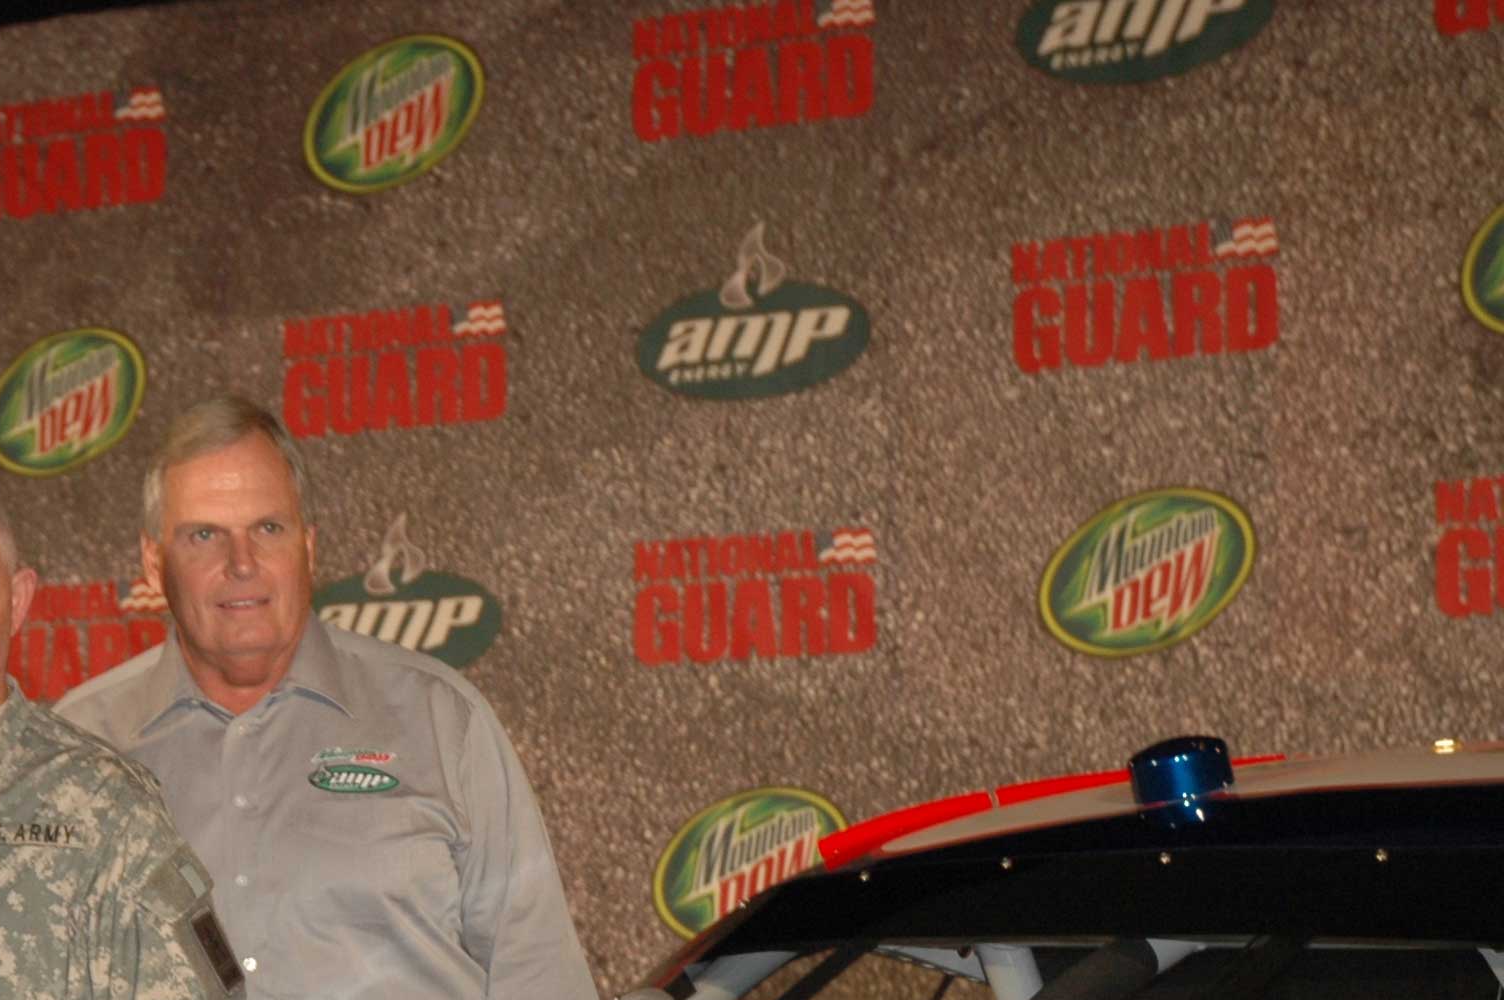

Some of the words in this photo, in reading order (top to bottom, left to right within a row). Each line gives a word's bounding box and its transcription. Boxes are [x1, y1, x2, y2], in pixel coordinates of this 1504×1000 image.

[632, 1, 815, 58] NATIONAL
[632, 35, 874, 142] GUARD
[1012, 221, 1212, 284] NATIONAL
[284, 304, 452, 359] NATIONAL
[1012, 265, 1278, 375] GUARD
[283, 344, 505, 439] GUARD
[635, 530, 816, 582] NATIONAL
[634, 571, 876, 667] GUARD
[12, 822, 76, 844] ARMY
